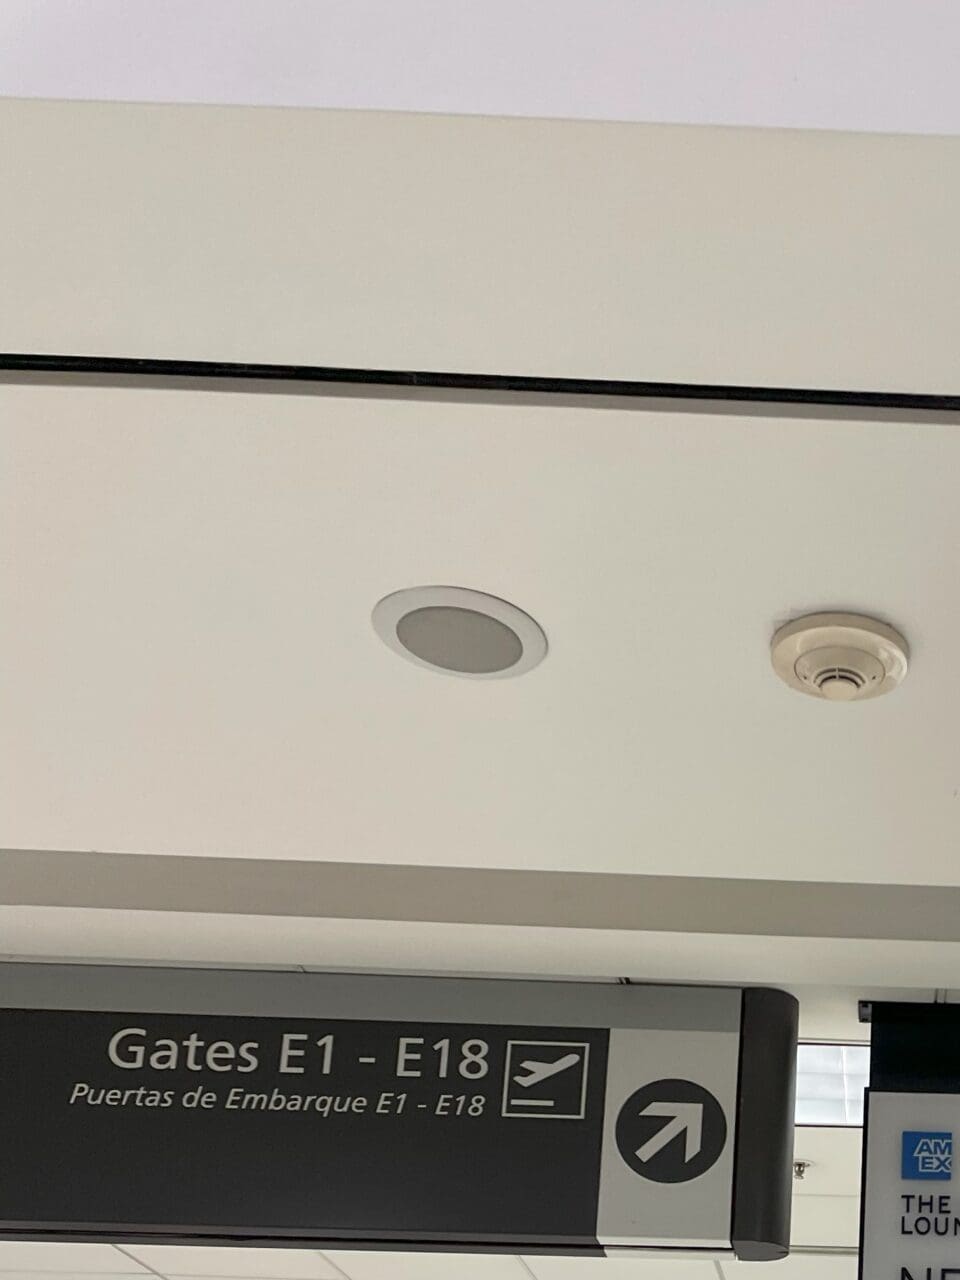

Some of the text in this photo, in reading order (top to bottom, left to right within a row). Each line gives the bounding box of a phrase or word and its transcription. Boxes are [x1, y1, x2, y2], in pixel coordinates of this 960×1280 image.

[109, 1027, 259, 1073] Gates
[279, 1033, 335, 1074] E1
[396, 1037, 489, 1080] E18
[69, 1083, 175, 1107] Puertas
[183, 1085, 217, 1109] de
[225, 1088, 367, 1118] Embarque
[375, 1092, 407, 1114] E1
[435, 1094, 486, 1116] E18
[913, 1139, 952, 1156] AM
[919, 1155, 952, 1172] EX
[901, 1194, 952, 1216] THE
